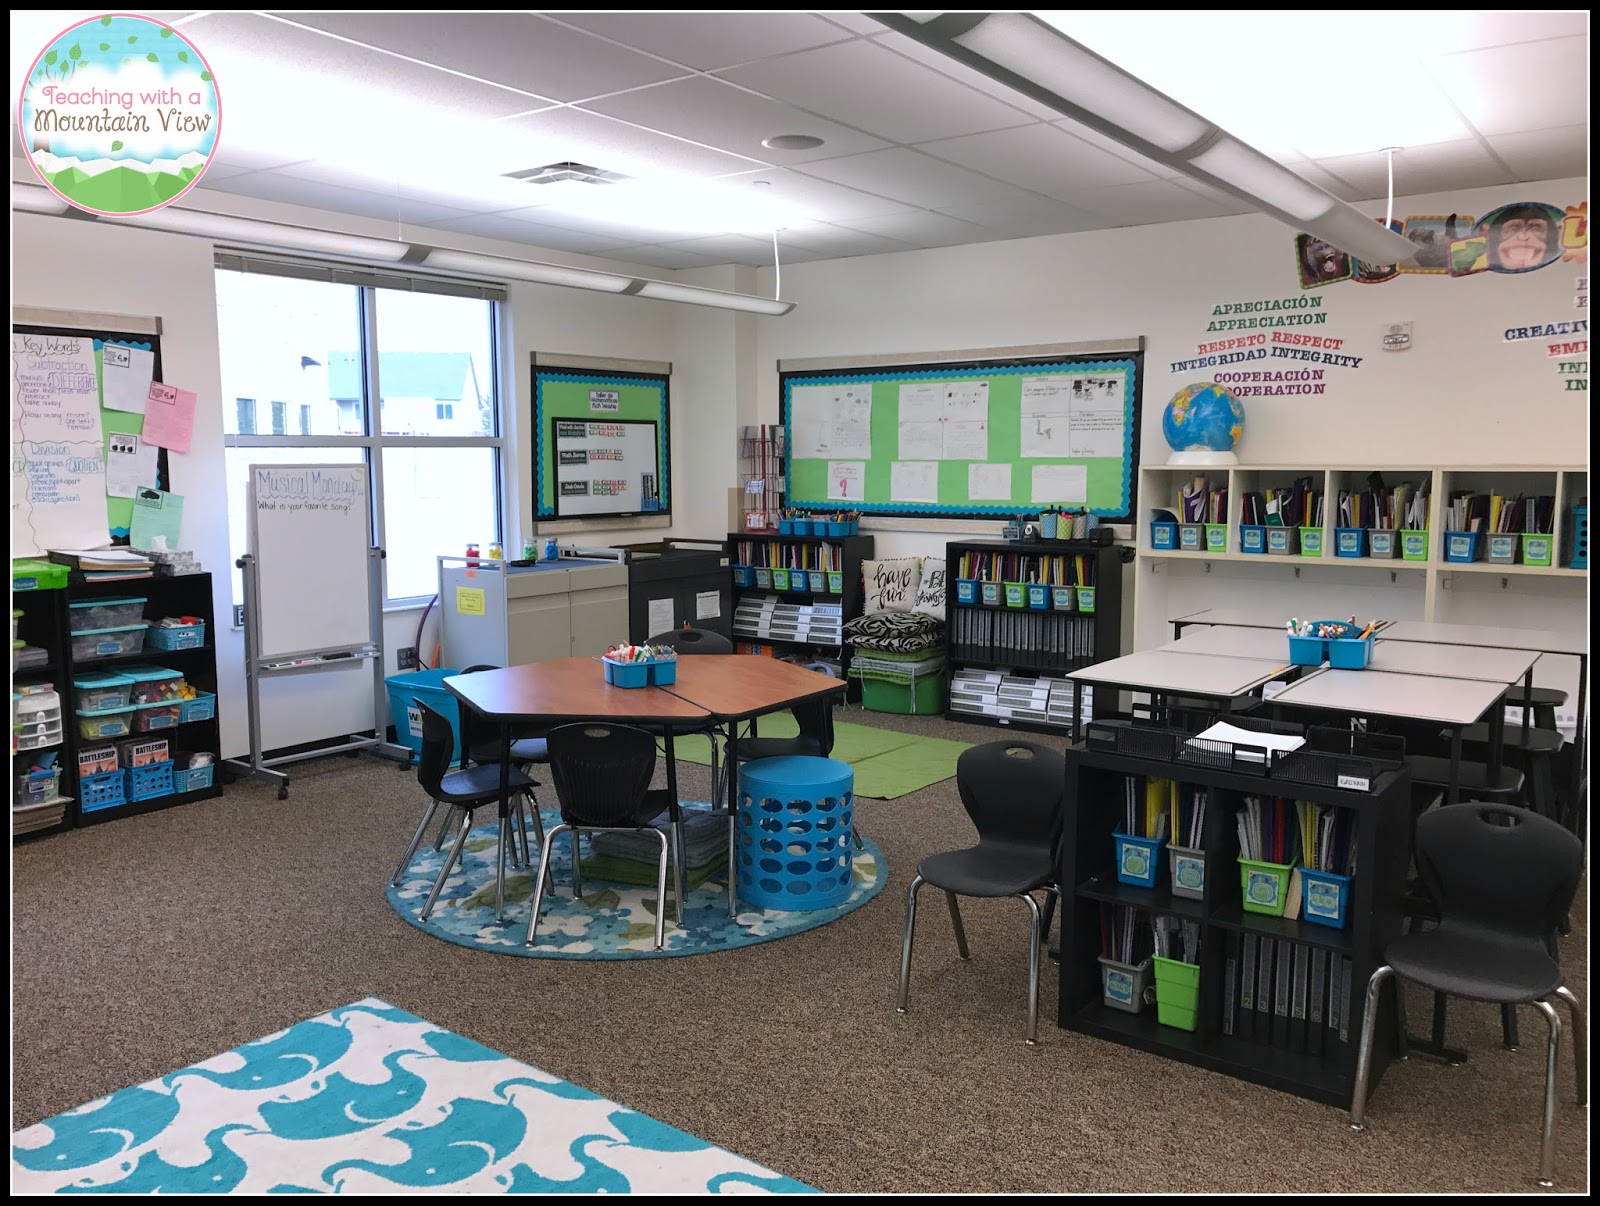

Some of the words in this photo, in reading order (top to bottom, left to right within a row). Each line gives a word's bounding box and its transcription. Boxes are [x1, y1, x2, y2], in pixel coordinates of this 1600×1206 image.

[1212, 294, 1323, 316] APRECIACIÓN
[1206, 312, 1328, 332] APPRECIATION
[24, 336, 43, 354] Key
[46, 337, 80, 352] Words
[1197, 333, 1266, 355] RESPETO
[1270, 331, 1343, 350] RESPECT
[26, 355, 88, 371] Subtraction
[1170, 348, 1267, 373] INTEGRIDAD
[1270, 346, 1363, 369] INTEGRITY
[1213, 368, 1325, 384] COOPERACIÓN
[1227, 383, 1326, 397] OPERATION
[258, 471, 309, 495] Musical
[311, 471, 358, 504] Monday
[257, 501, 276, 510] What
[287, 504, 302, 514] your
[304, 502, 328, 511] favorite
[331, 502, 351, 516] song?
[874, 563, 912, 589] have
[870, 587, 906, 609] fun
[135, 742, 167, 754] BATTLESHIP
[80, 751, 116, 763] BATTLESHIP
[1244, 998, 1250, 1007] 2
[1260, 1001, 1266, 1010] 3
[1278, 1004, 1284, 1013] 4
[1296, 1007, 1302, 1016] 5
[1313, 1011, 1319, 1020] 6
[1225, 1023, 1229, 1032] 1
[1333, 1017, 1339, 1026] 7
[1341, 1029, 1348, 1039] 8
